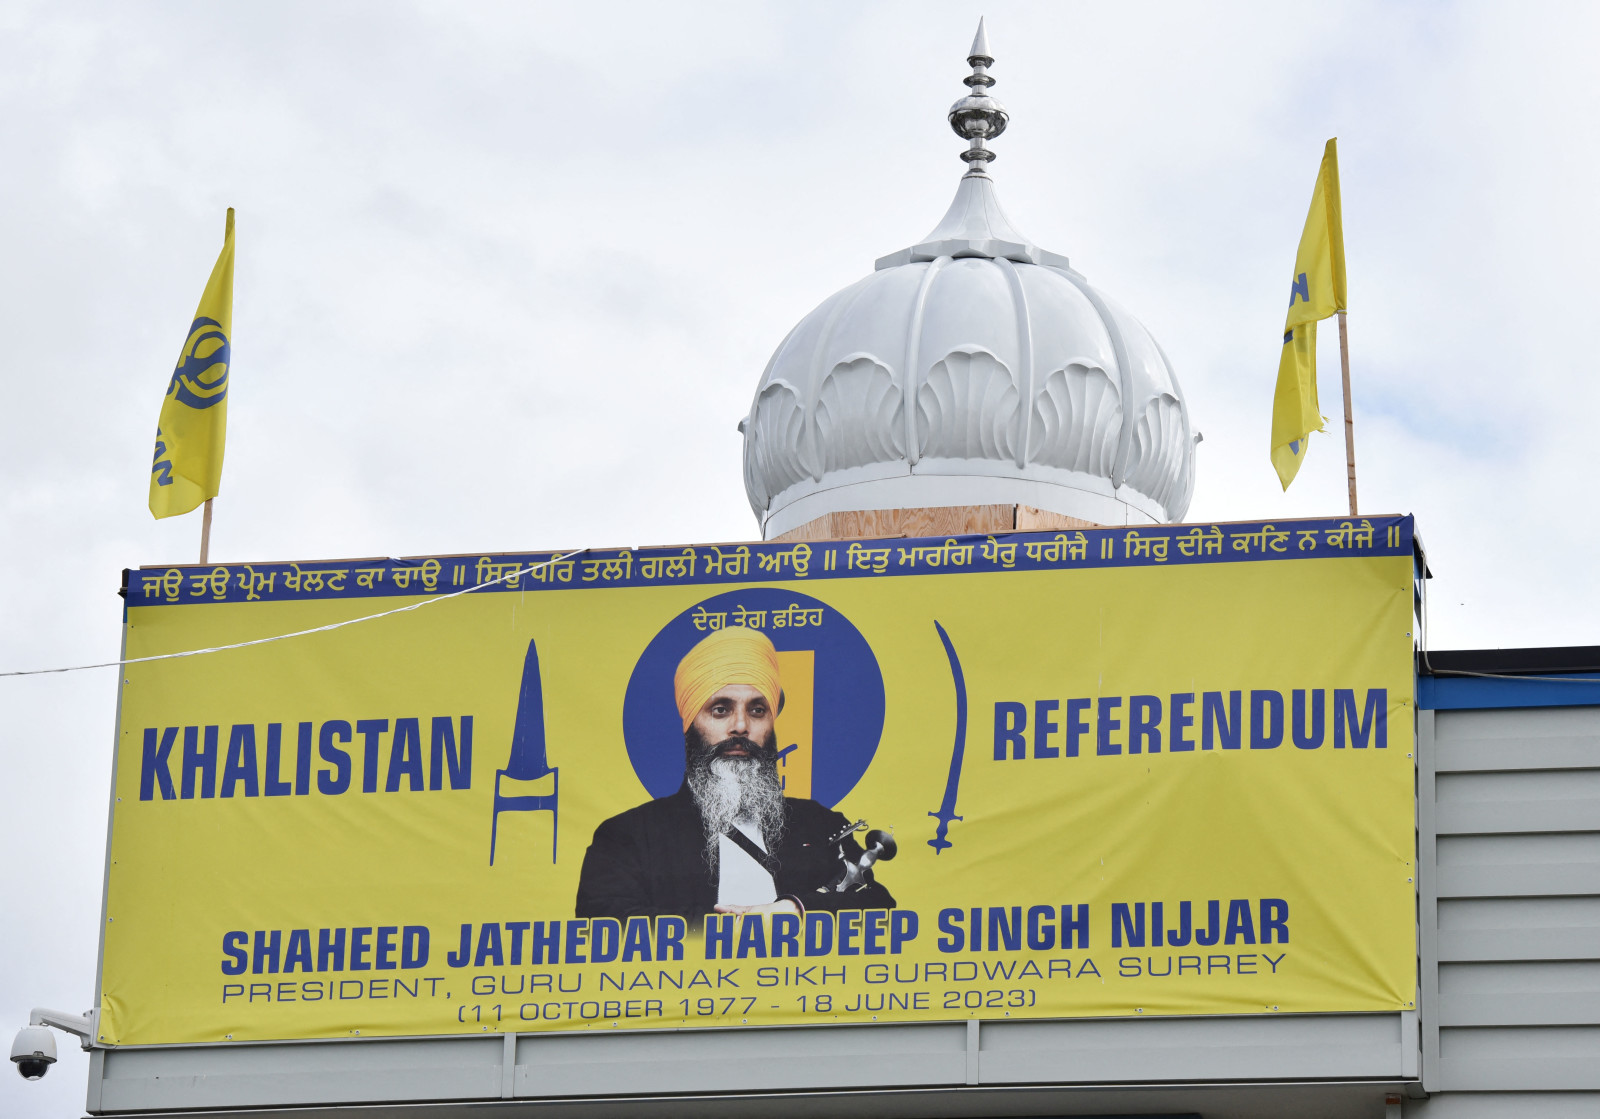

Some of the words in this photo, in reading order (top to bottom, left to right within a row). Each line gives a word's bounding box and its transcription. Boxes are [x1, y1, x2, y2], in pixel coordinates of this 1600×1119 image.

[142, 569, 183, 602] ਜਉ
[190, 567, 230, 600] ਤਉ
[236, 566, 276, 601] ਪ੍ਰੇਮ
[282, 563, 349, 592] ਖੇਲਣ
[356, 568, 386, 589] ਕਾ
[392, 558, 441, 592] ਚਾਉ
[475, 556, 523, 589] ਸਿਰੁ
[528, 553, 576, 583] ਧਰਿ
[581, 550, 634, 582] ਤਲੀ
[640, 547, 697, 578] ਗਲੀ
[704, 546, 751, 576] ਮੇਰੀ
[758, 543, 812, 577] ਆਉ
[847, 542, 892, 573] ਇਤੁ
[898, 538, 975, 567] ਮਾਰਗਿ
[980, 535, 1018, 568] ਪੈਰੁ
[1024, 531, 1089, 562] ਧਰੀਜੈ
[1124, 531, 1170, 562] ਸਿਰੁ
[1176, 526, 1225, 557] ਦੀਜੈ
[1230, 525, 1291, 553] ਕਾਣਿ
[1297, 530, 1319, 551] ਨ
[1325, 519, 1375, 549] ਕੀਜੈ
[692, 606, 727, 631] ਦੇਗ
[732, 604, 767, 629] ਤੇਗ
[772, 603, 824, 629] ਫ਼ਤਿਹ
[139, 715, 474, 802] KHALISTAN
[993, 688, 1388, 761] REFERENDUM
[221, 925, 431, 976] SHAHEED
[446, 916, 686, 969] JATHEDAR
[704, 909, 920, 960] HARDEEP
[937, 903, 1090, 954] SINGH
[1111, 898, 1290, 949] NIJJAR
[222, 977, 451, 1004] PRESIDENT,
[471, 973, 582, 996] GURU
[599, 967, 740, 992] NANAK
[756, 965, 847, 987] SIKH
[864, 958, 1102, 984] GURDWARA
[1118, 953, 1287, 978] SURREY
[457, 1004, 502, 1023] (11
[519, 999, 663, 1021] OCTOBER
[679, 996, 757, 1016] 1977
[796, 994, 833, 1013] 18
[844, 991, 930, 1012] JUNE
[943, 989, 1036, 1009] 2023)
